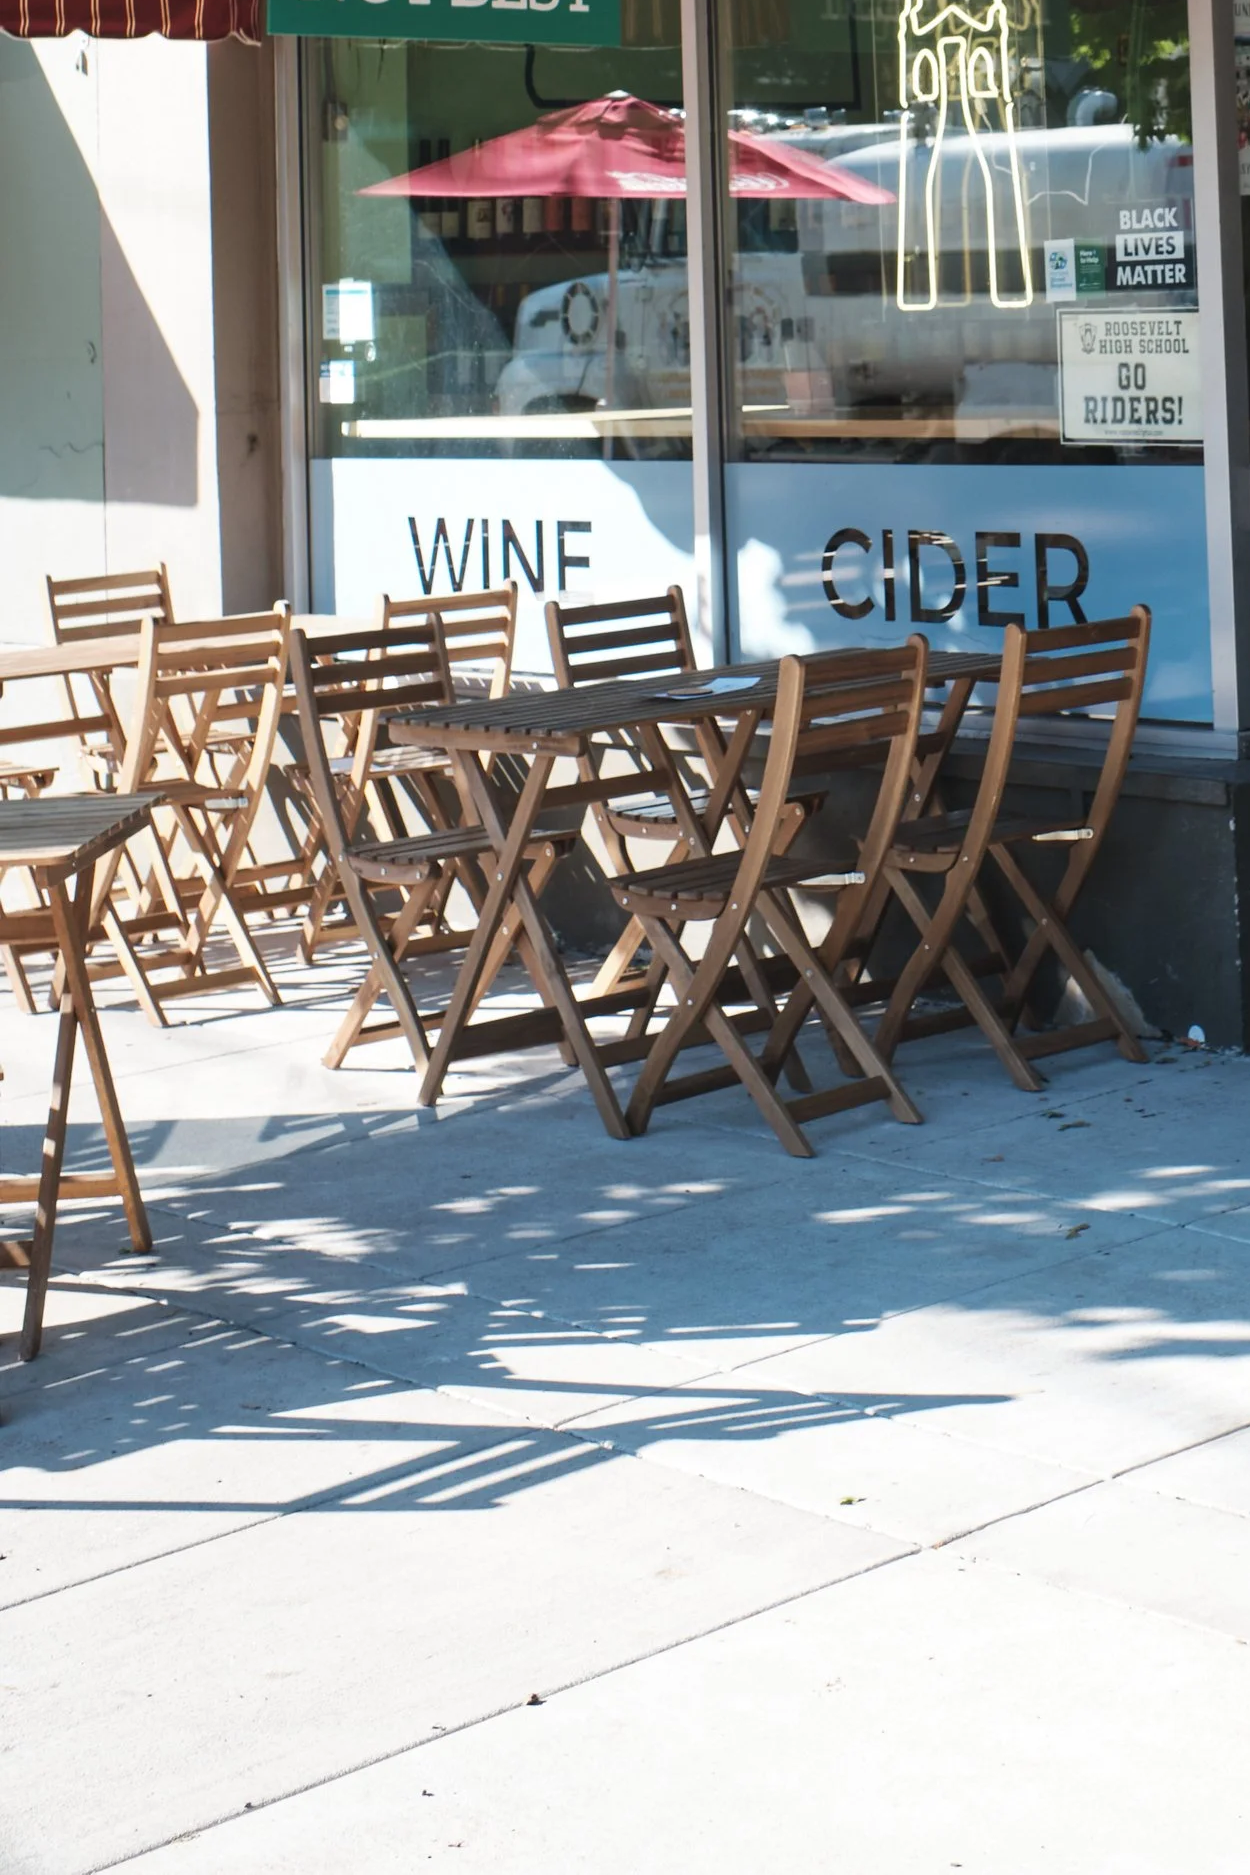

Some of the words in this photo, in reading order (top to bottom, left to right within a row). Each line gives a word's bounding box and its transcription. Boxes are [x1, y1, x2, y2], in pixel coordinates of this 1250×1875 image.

[1119, 207, 1178, 229] BLACK
[1123, 236, 1176, 256] LIVES
[1116, 264, 1187, 286] MATTER
[1104, 320, 1182, 336] ROOSEVELT
[1099, 339, 1133, 354] HIGH
[1139, 338, 1189, 354] SCHOOL
[1118, 362, 1146, 390] GO
[1084, 396, 1183, 425] RIDERS!
[408, 515, 593, 602] WINE
[822, 526, 1088, 629] CIDER
